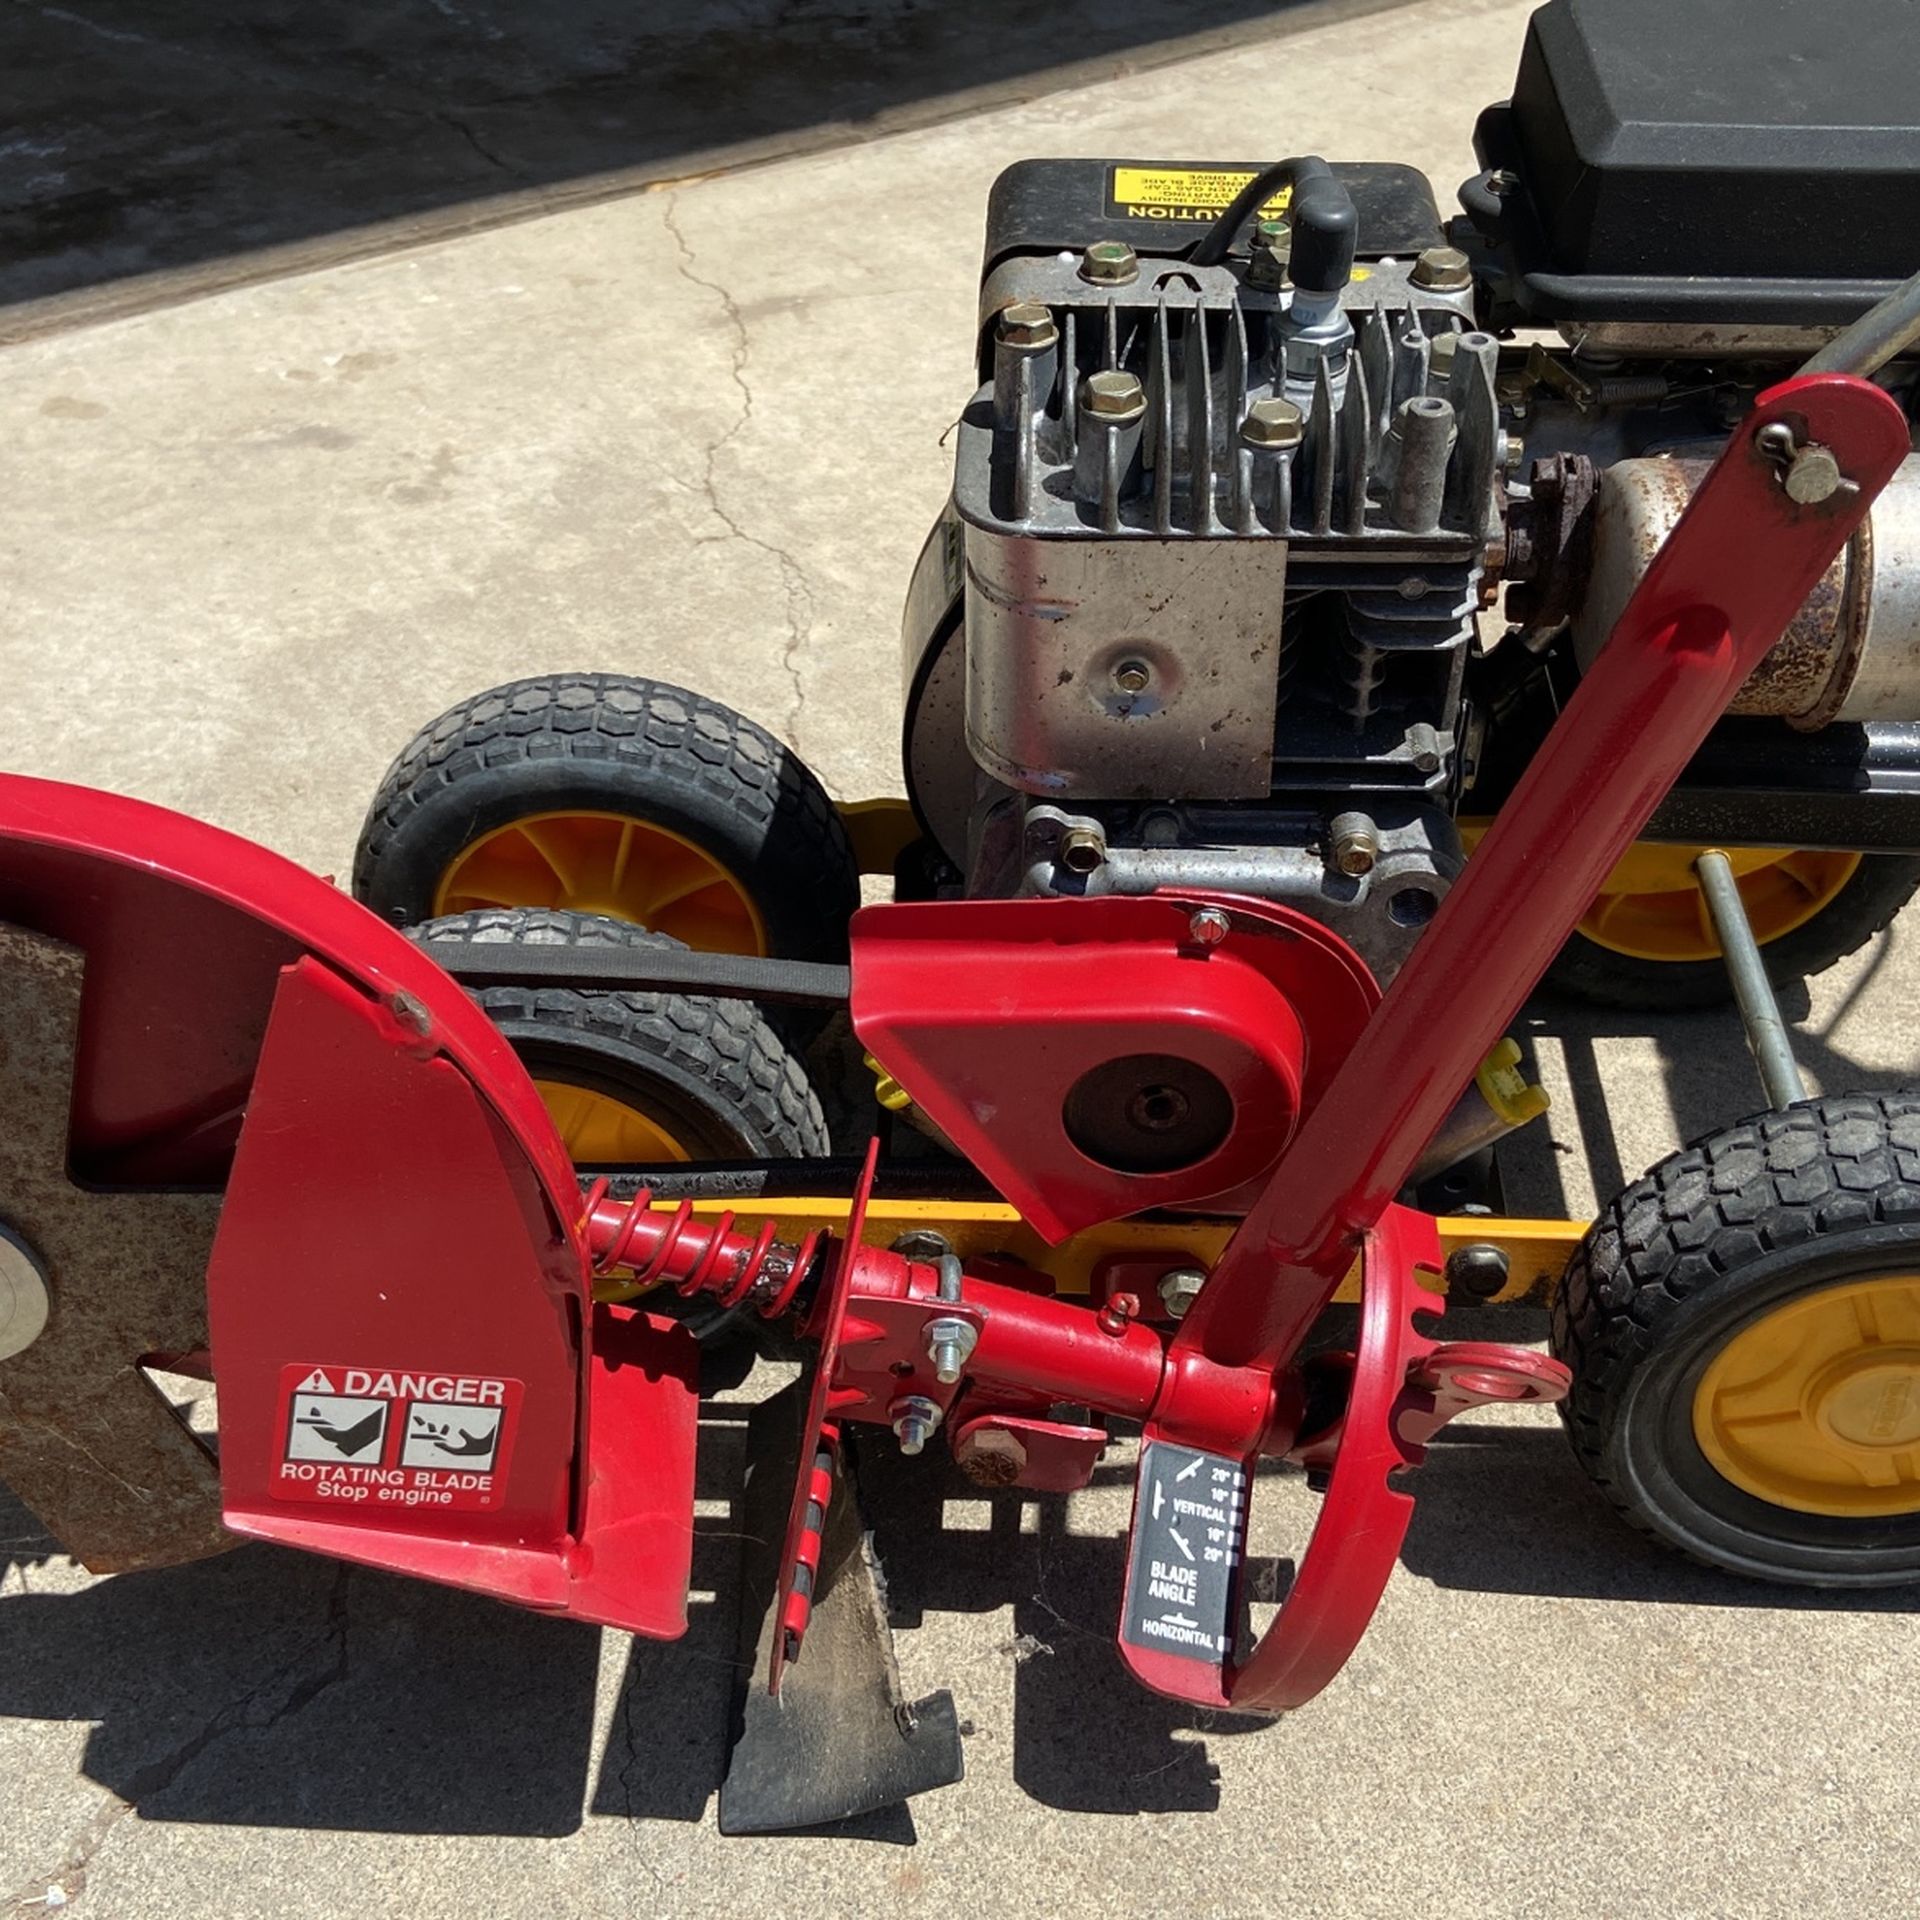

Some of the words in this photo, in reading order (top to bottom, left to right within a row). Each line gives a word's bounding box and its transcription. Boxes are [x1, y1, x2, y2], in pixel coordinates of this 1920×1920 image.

[1129, 206, 1224, 221] AUTION
[344, 1370, 505, 1404] DANGER
[280, 1463, 405, 1485] ROTATING
[414, 1472, 493, 1491] BLADE
[1211, 1467, 1231, 1482] 20°
[317, 1481, 369, 1501] Stop
[378, 1487, 453, 1505] engine
[1173, 1498, 1226, 1523] VERTICAL
[1203, 1546, 1224, 1562] 20°
[1150, 1560, 1198, 1587] BLADE
[1148, 1581, 1197, 1606] ANGLE
[1142, 1618, 1214, 1649] HORIZONTAL
